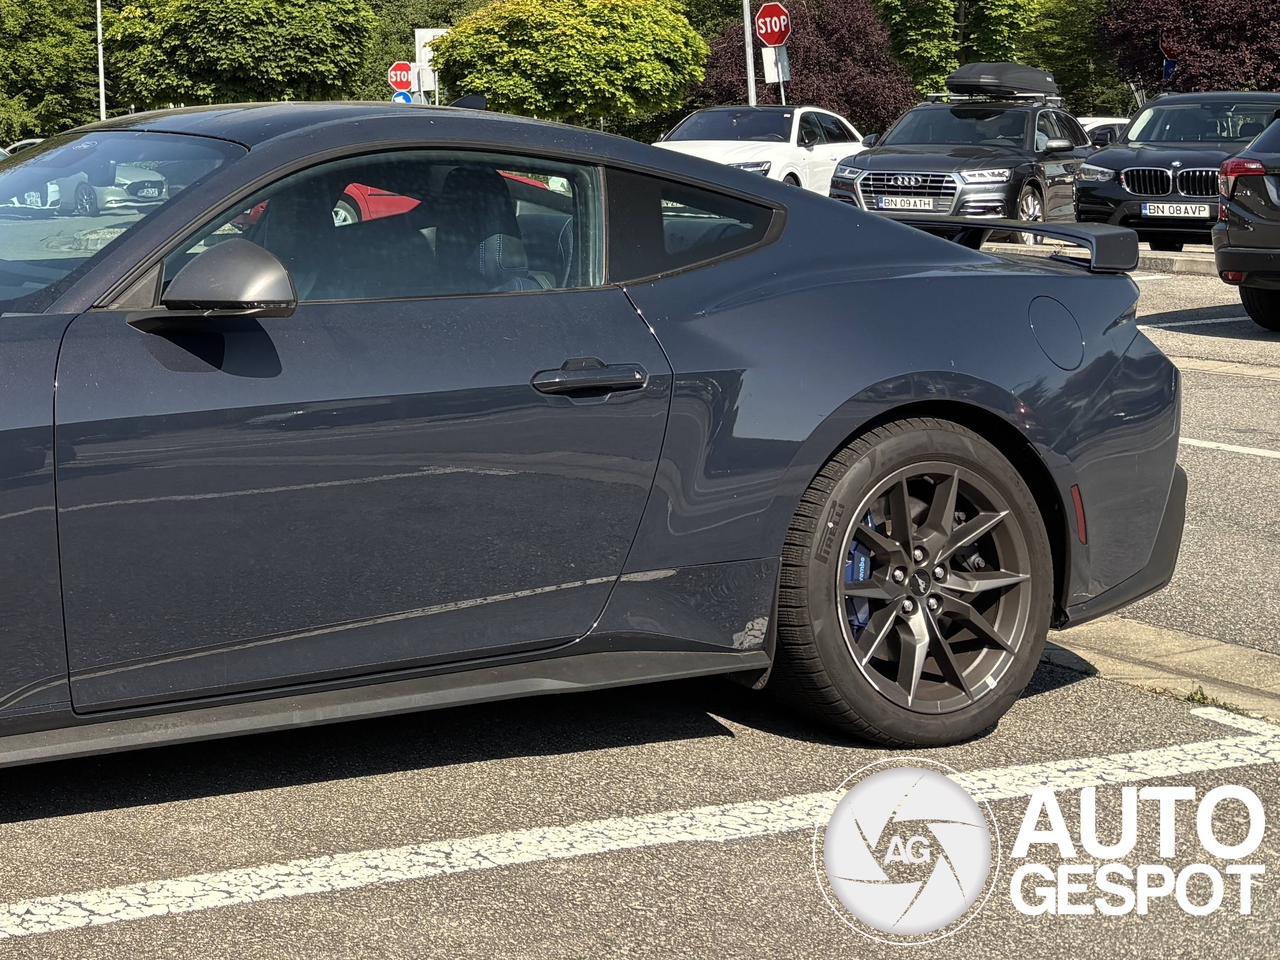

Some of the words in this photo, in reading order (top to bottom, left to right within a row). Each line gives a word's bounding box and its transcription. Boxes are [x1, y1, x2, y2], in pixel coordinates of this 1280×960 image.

[758, 15, 788, 34] STOP
[883, 198, 898, 208] BN
[900, 199, 911, 208] 09
[913, 199, 931, 208] ATH
[1148, 204, 1166, 215] BN
[1168, 205, 1182, 215] 08
[1183, 205, 1207, 216] AVP
[815, 500, 845, 565] PIRELLI
